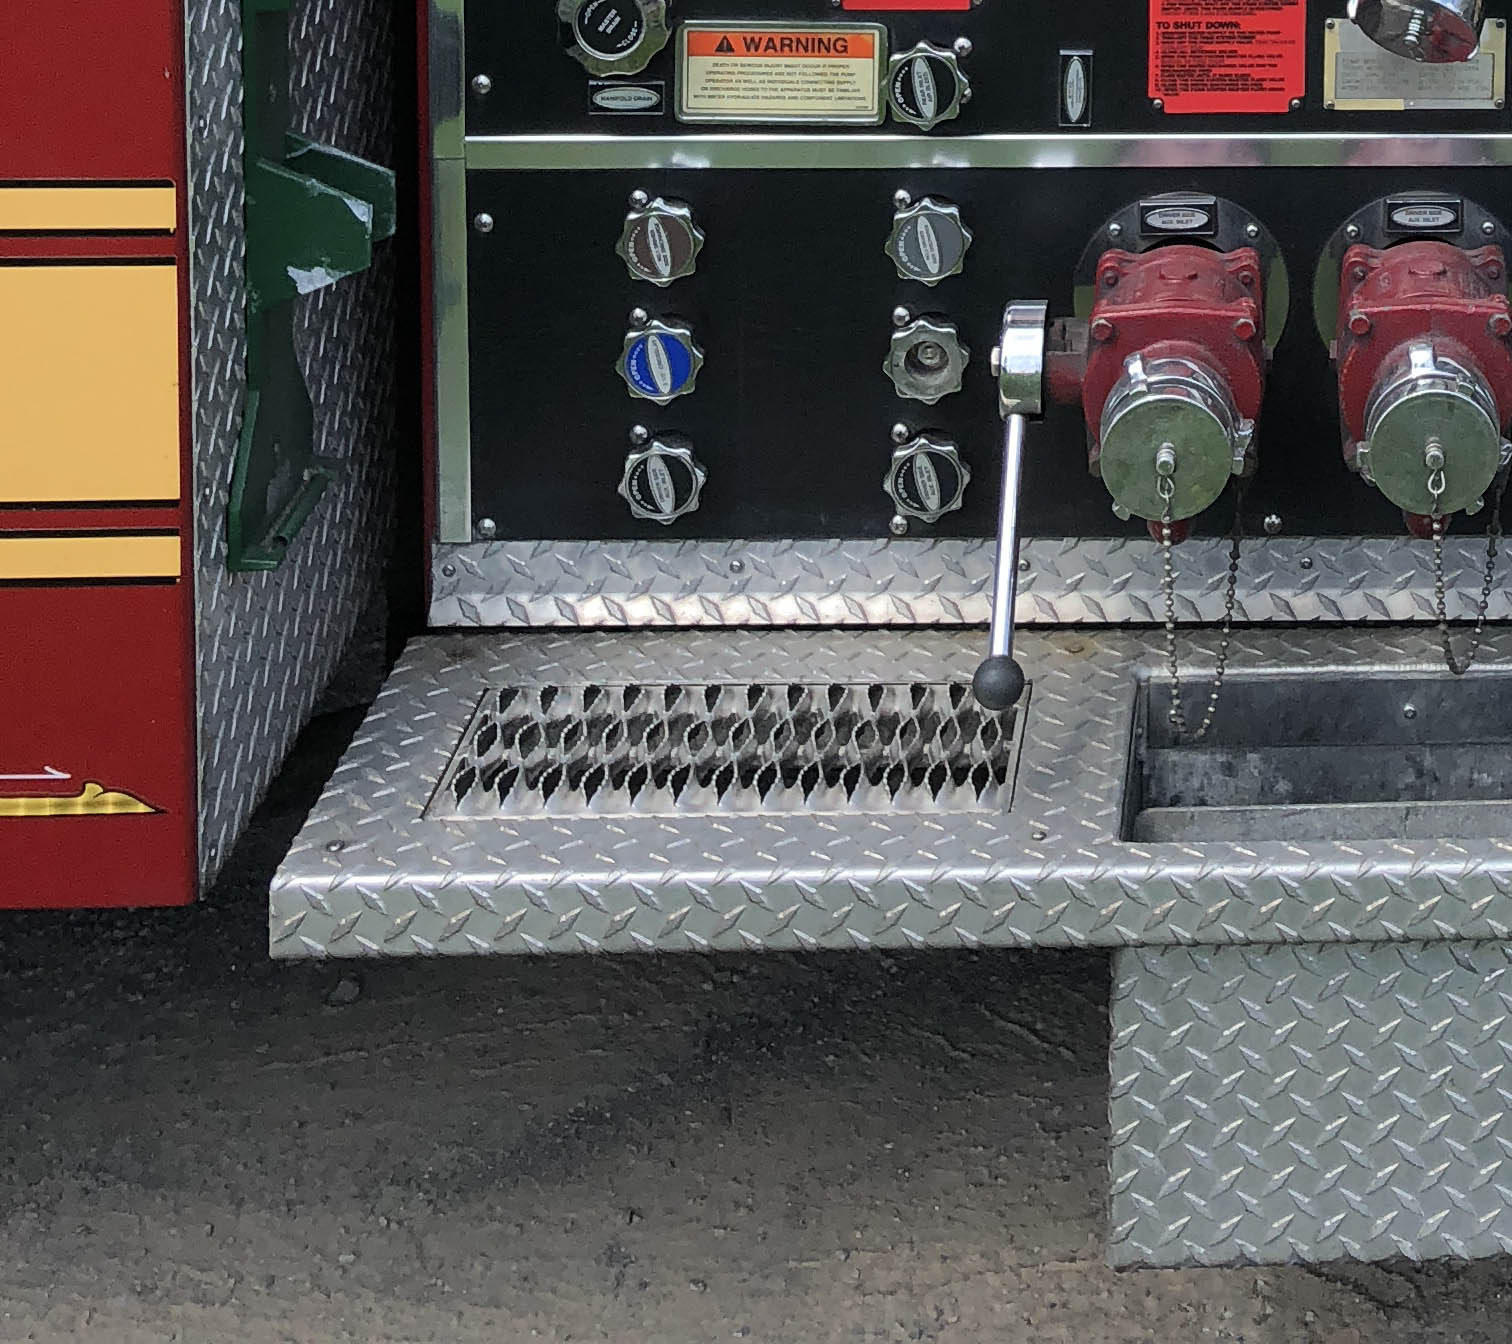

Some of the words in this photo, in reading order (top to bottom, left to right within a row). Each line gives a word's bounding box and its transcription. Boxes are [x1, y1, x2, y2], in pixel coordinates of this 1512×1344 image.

[598, 9, 617, 32] MASTER
[1205, 22, 1241, 30] DOWN:
[743, 37, 848, 53] WARNING
[895, 81, 904, 104] OPEN
